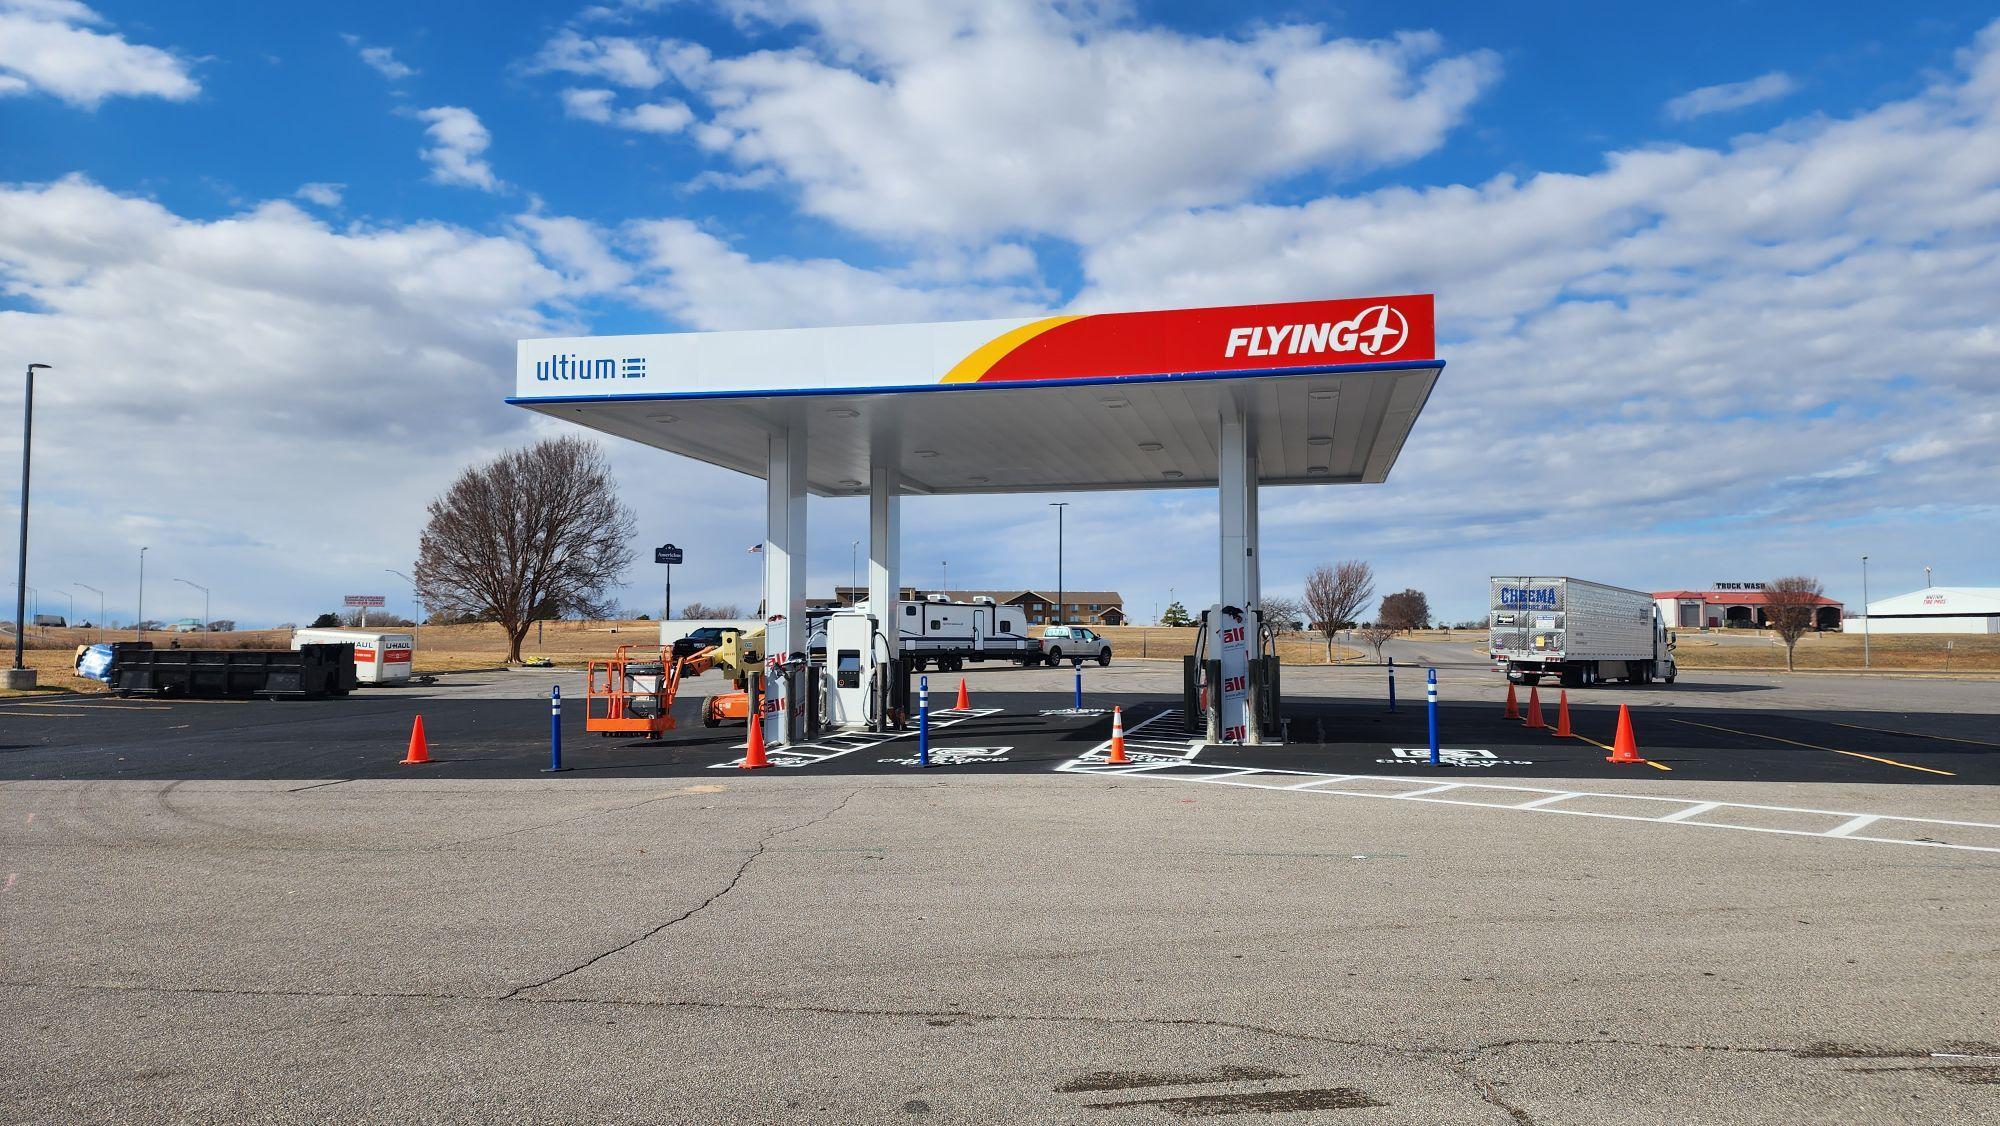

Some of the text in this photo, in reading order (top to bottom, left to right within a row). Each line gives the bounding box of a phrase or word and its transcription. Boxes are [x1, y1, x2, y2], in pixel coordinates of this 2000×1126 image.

[1225, 320, 1358, 358] FLYING
[537, 354, 616, 381] ultium
[1501, 587, 1556, 605] CHEEMA
[1716, 582, 1766, 590] TRUCK WASH
